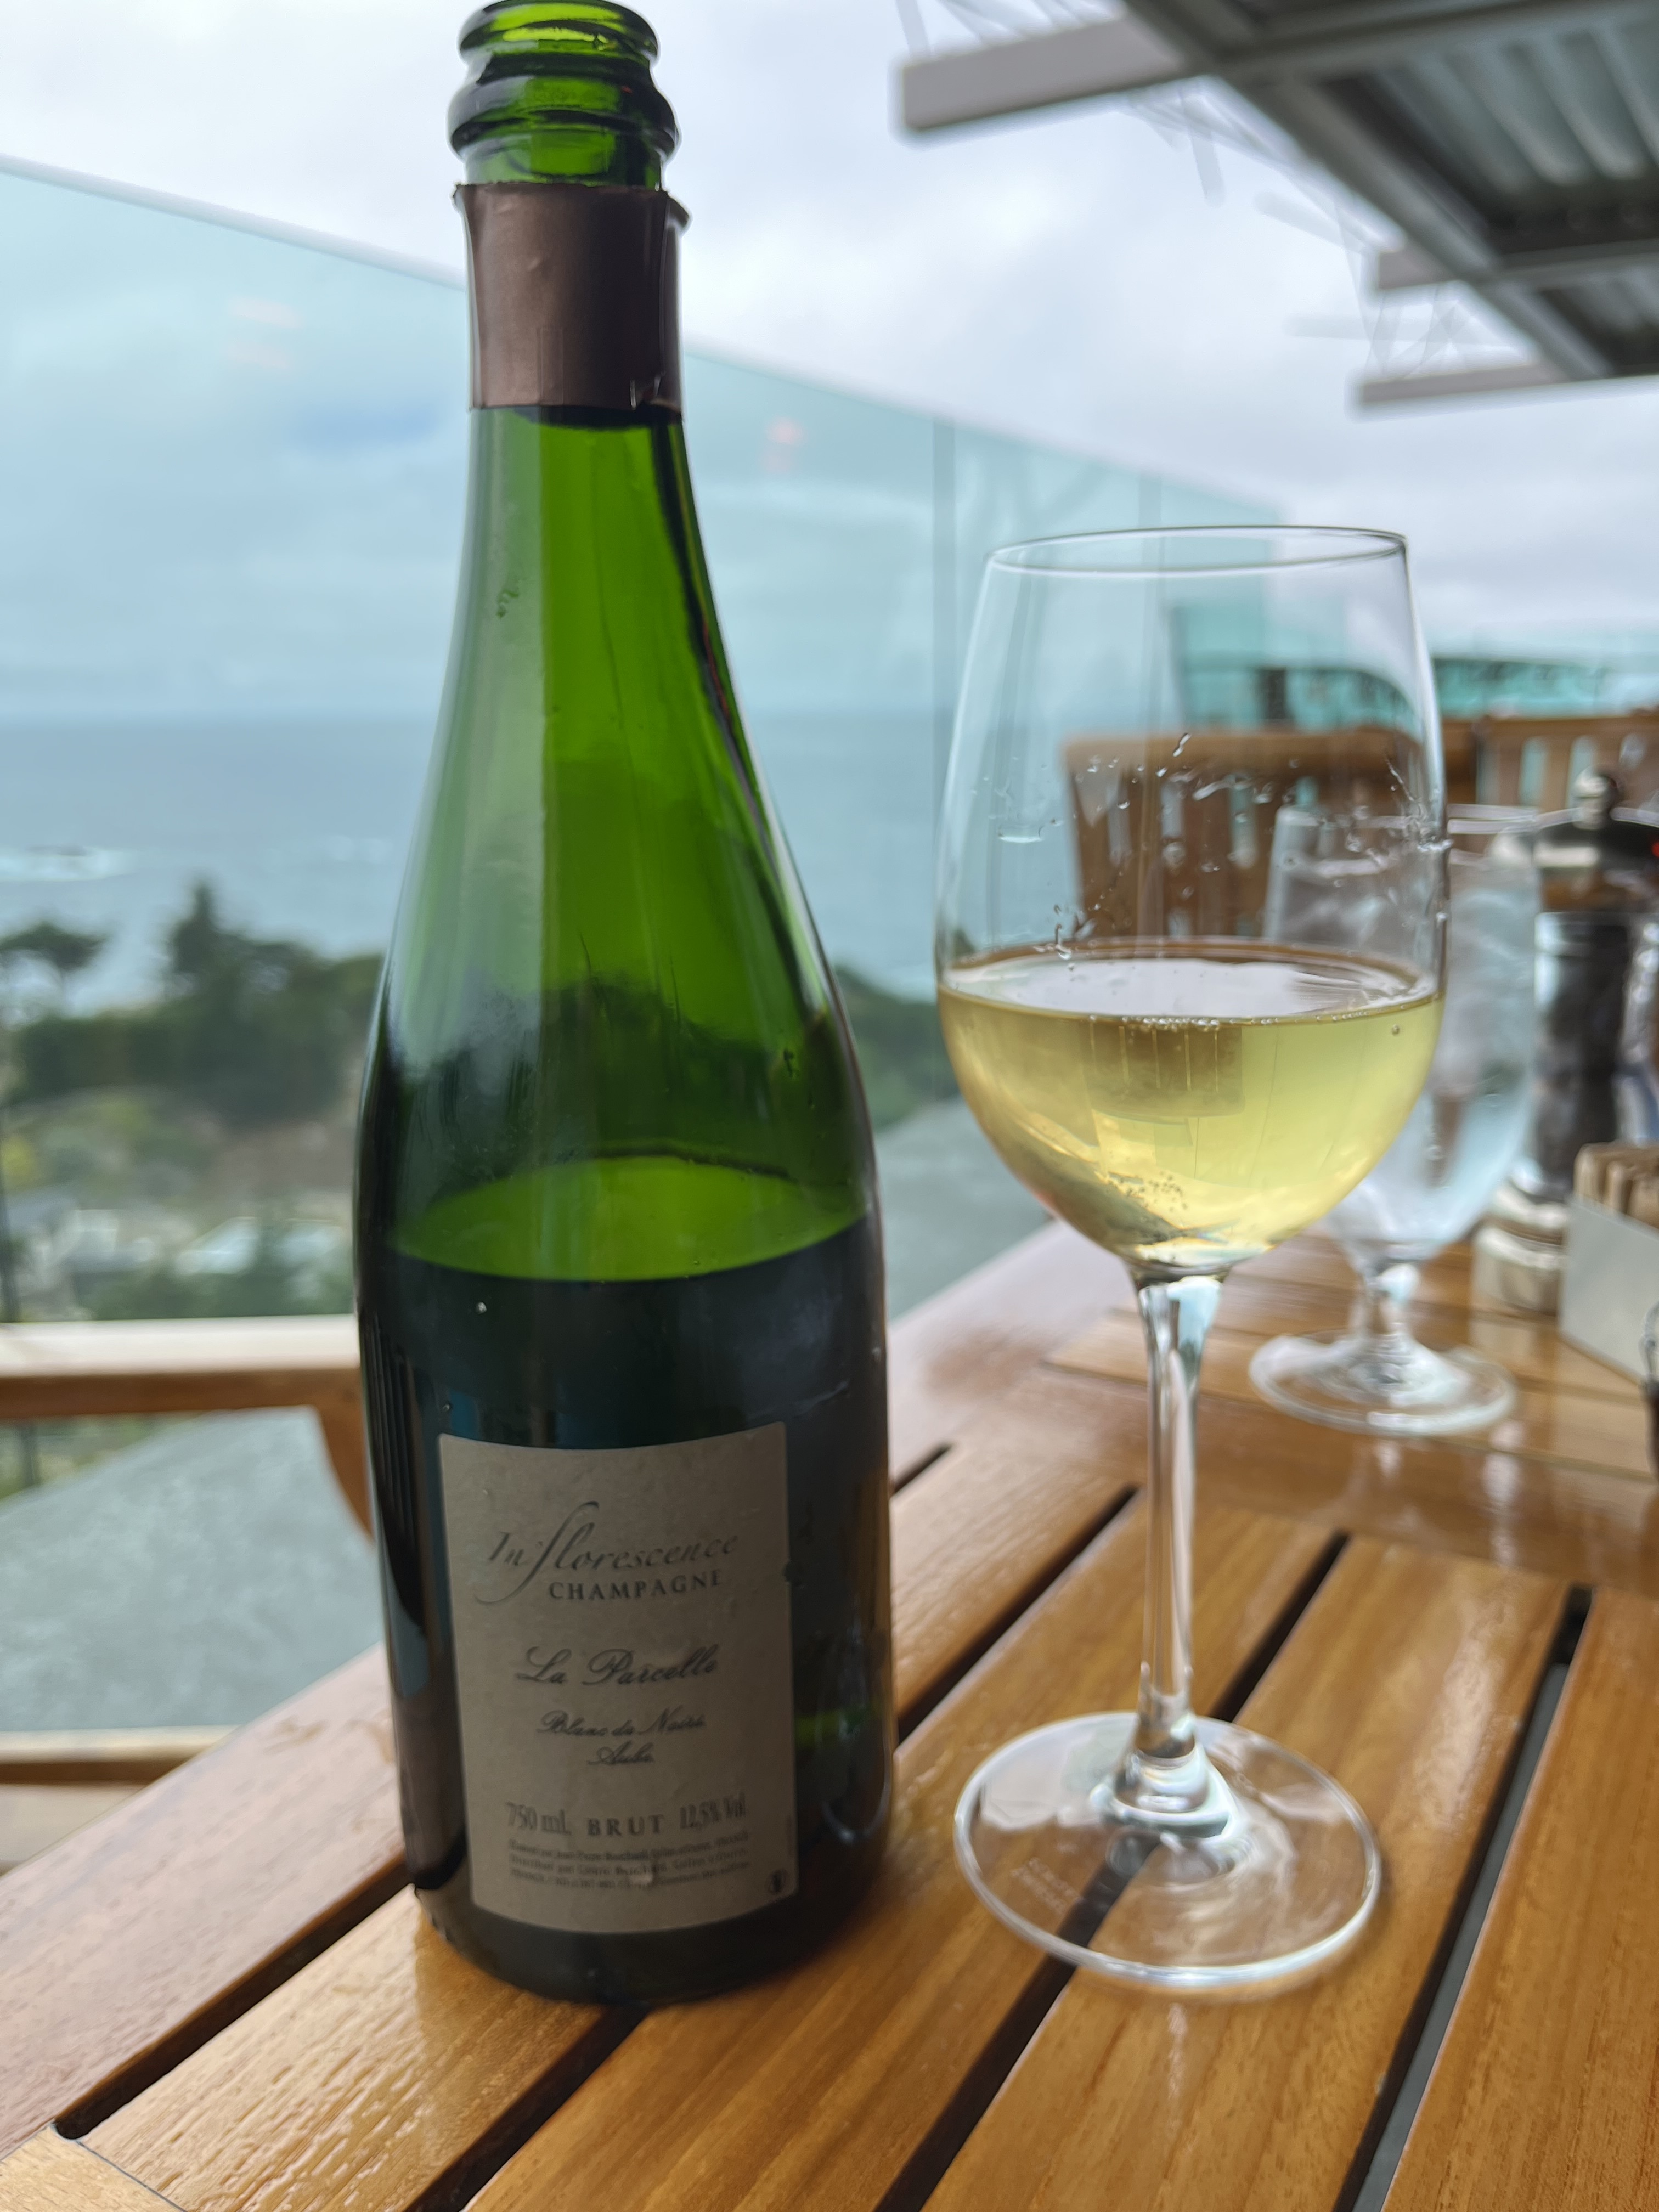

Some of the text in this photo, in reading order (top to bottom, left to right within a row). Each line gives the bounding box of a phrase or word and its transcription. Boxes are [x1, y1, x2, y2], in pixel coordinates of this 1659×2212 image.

[548, 1568, 723, 1601] CHAMPAGNE
[515, 1644, 721, 1685] La Parcelle
[535, 1709, 608, 1736] Blanc
[505, 1801, 538, 1831] 750
[586, 1814, 665, 1837] BRUT
